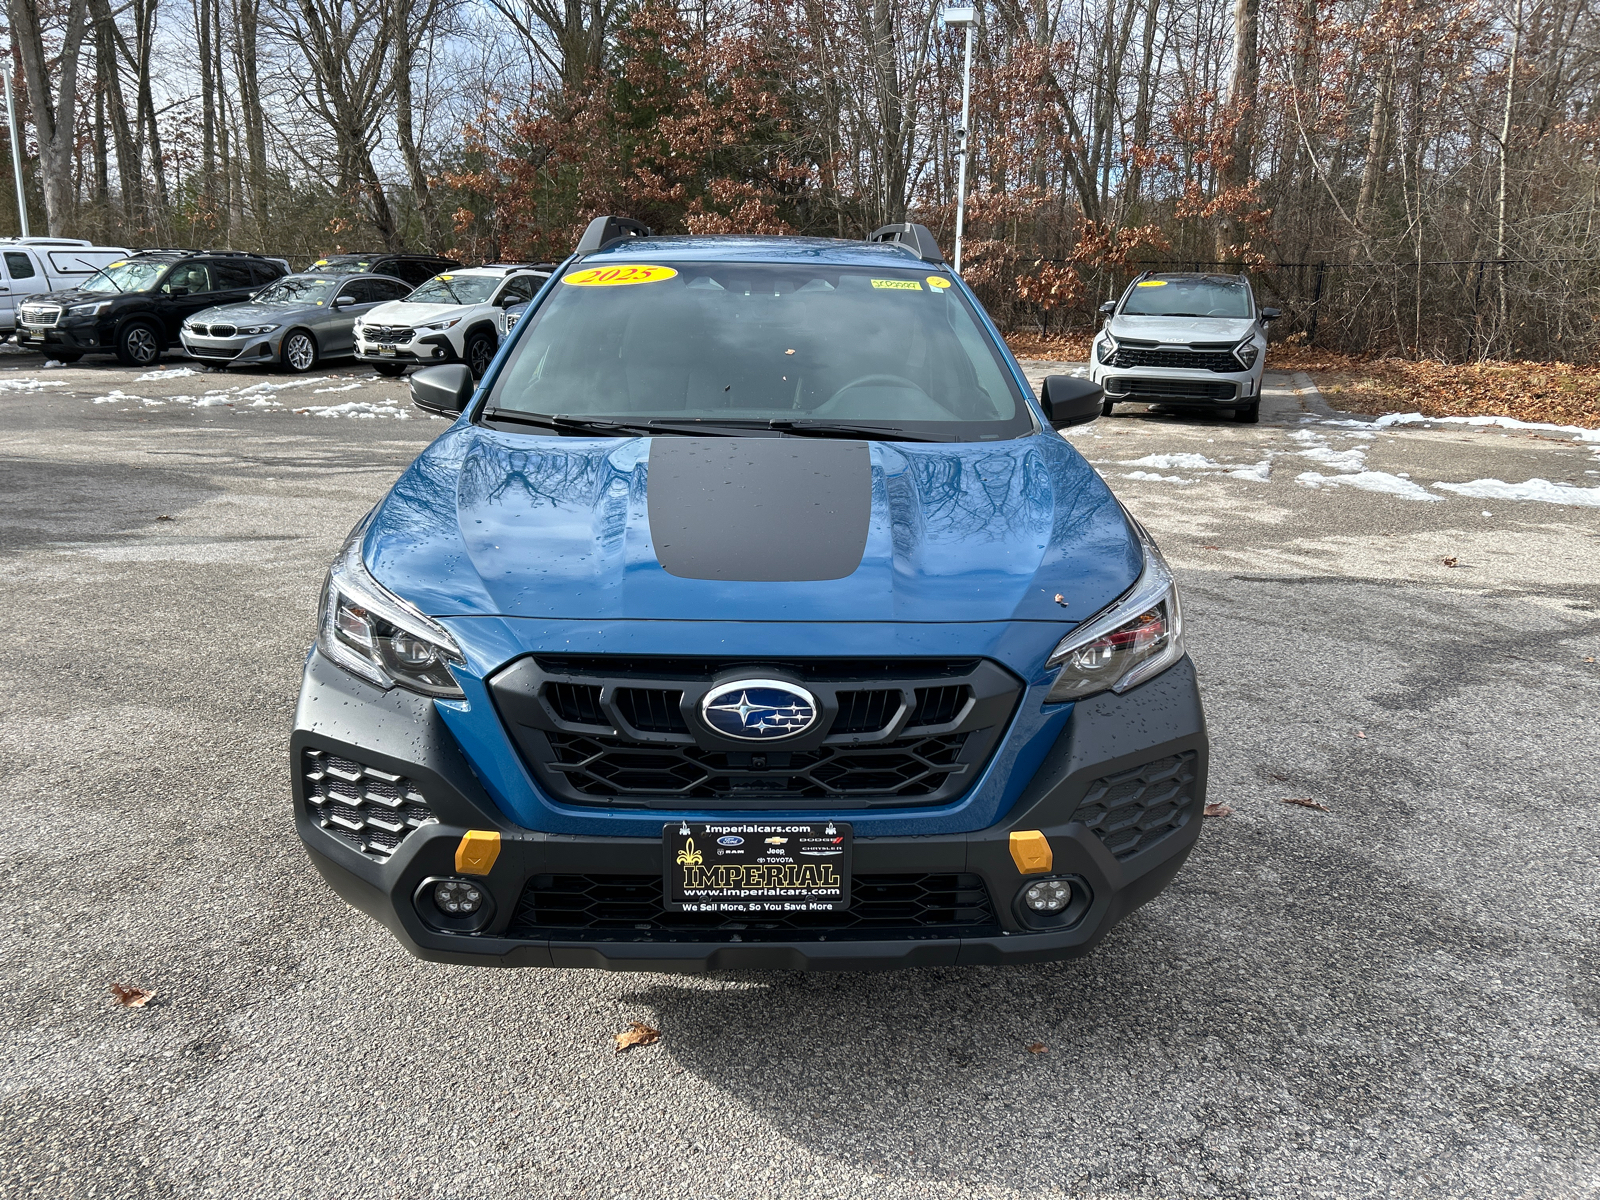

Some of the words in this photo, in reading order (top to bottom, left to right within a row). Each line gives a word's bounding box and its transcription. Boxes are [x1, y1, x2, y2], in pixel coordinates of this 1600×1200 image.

[577, 267, 658, 283] 2025
[705, 824, 811, 835] Imperialcars.com
[684, 864, 840, 888] IMPERIAL
[684, 887, 840, 897] www.imperialcars.com
[700, 903, 717, 911] Sell
[720, 903, 746, 912] More,
[749, 903, 761, 911] So
[784, 902, 807, 910] Save
[809, 902, 833, 910] More
